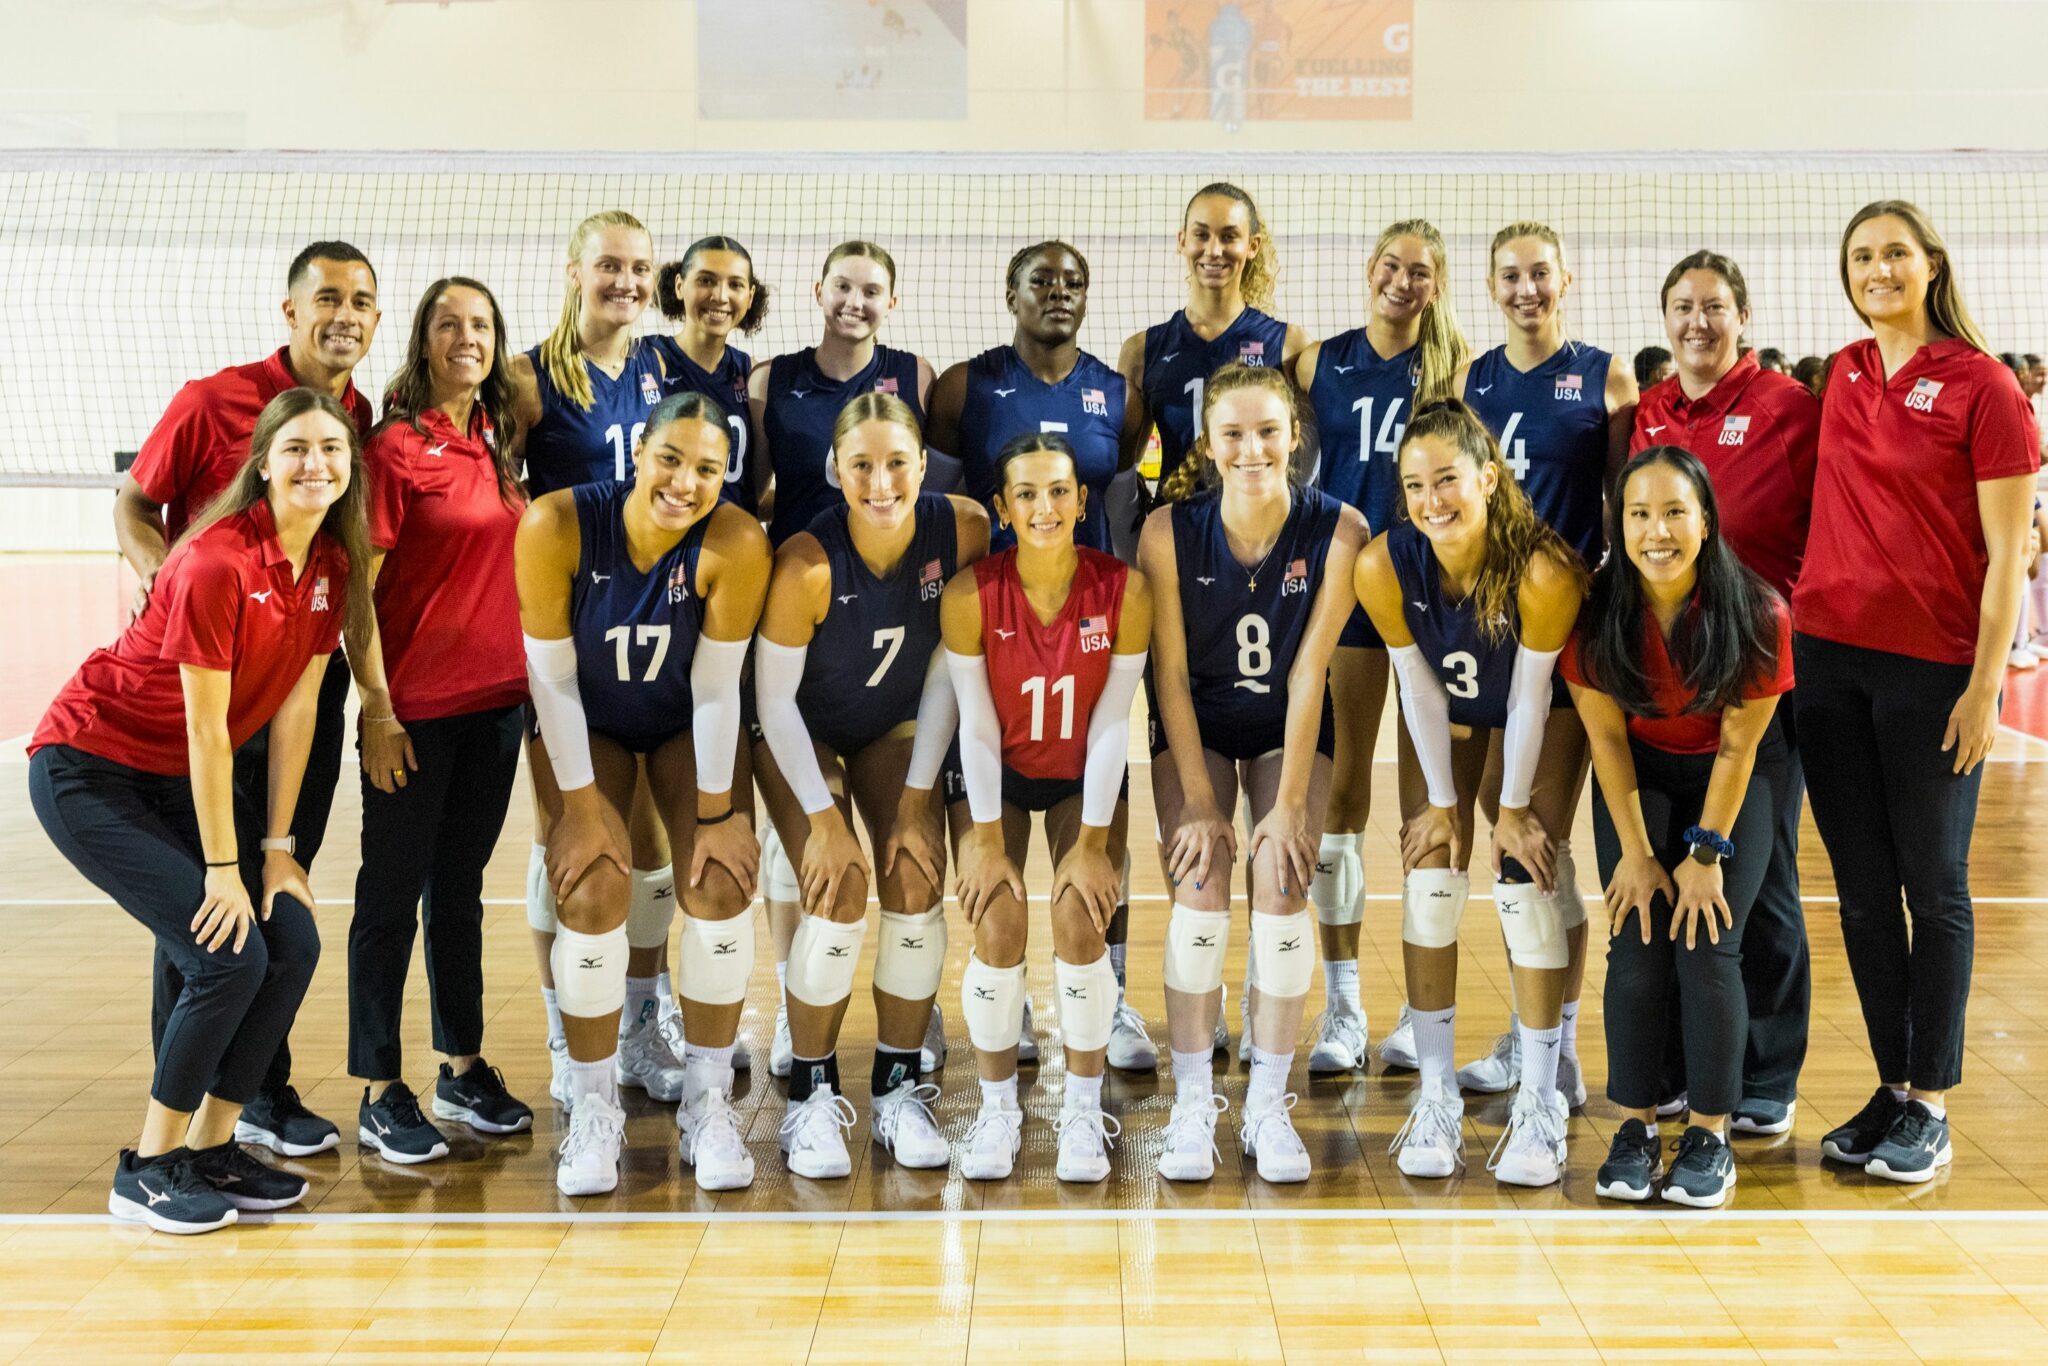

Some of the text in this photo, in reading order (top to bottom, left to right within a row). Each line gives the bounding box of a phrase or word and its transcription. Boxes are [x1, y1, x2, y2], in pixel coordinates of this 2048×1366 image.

[1383, 23, 1409, 53] G
[1216, 63, 1242, 90] G
[1296, 58, 1409, 74] FUELLING
[1296, 78, 1409, 96] THE BEST
[1555, 388, 1581, 401] USA
[1904, 391, 1934, 413] USA
[1083, 401, 1108, 417] USA
[1352, 396, 1405, 462] 14
[1718, 431, 1744, 446] USA
[1500, 412, 1531, 480] 4
[921, 579, 945, 601] USA
[1281, 577, 1307, 597] USA
[311, 595, 329, 612] USA
[605, 624, 671, 682] 17
[1081, 634, 1110, 653] USA
[1236, 613, 1271, 677] 8
[865, 625, 905, 687] 7
[1442, 650, 1479, 699] 3
[1021, 674, 1075, 741] 11
